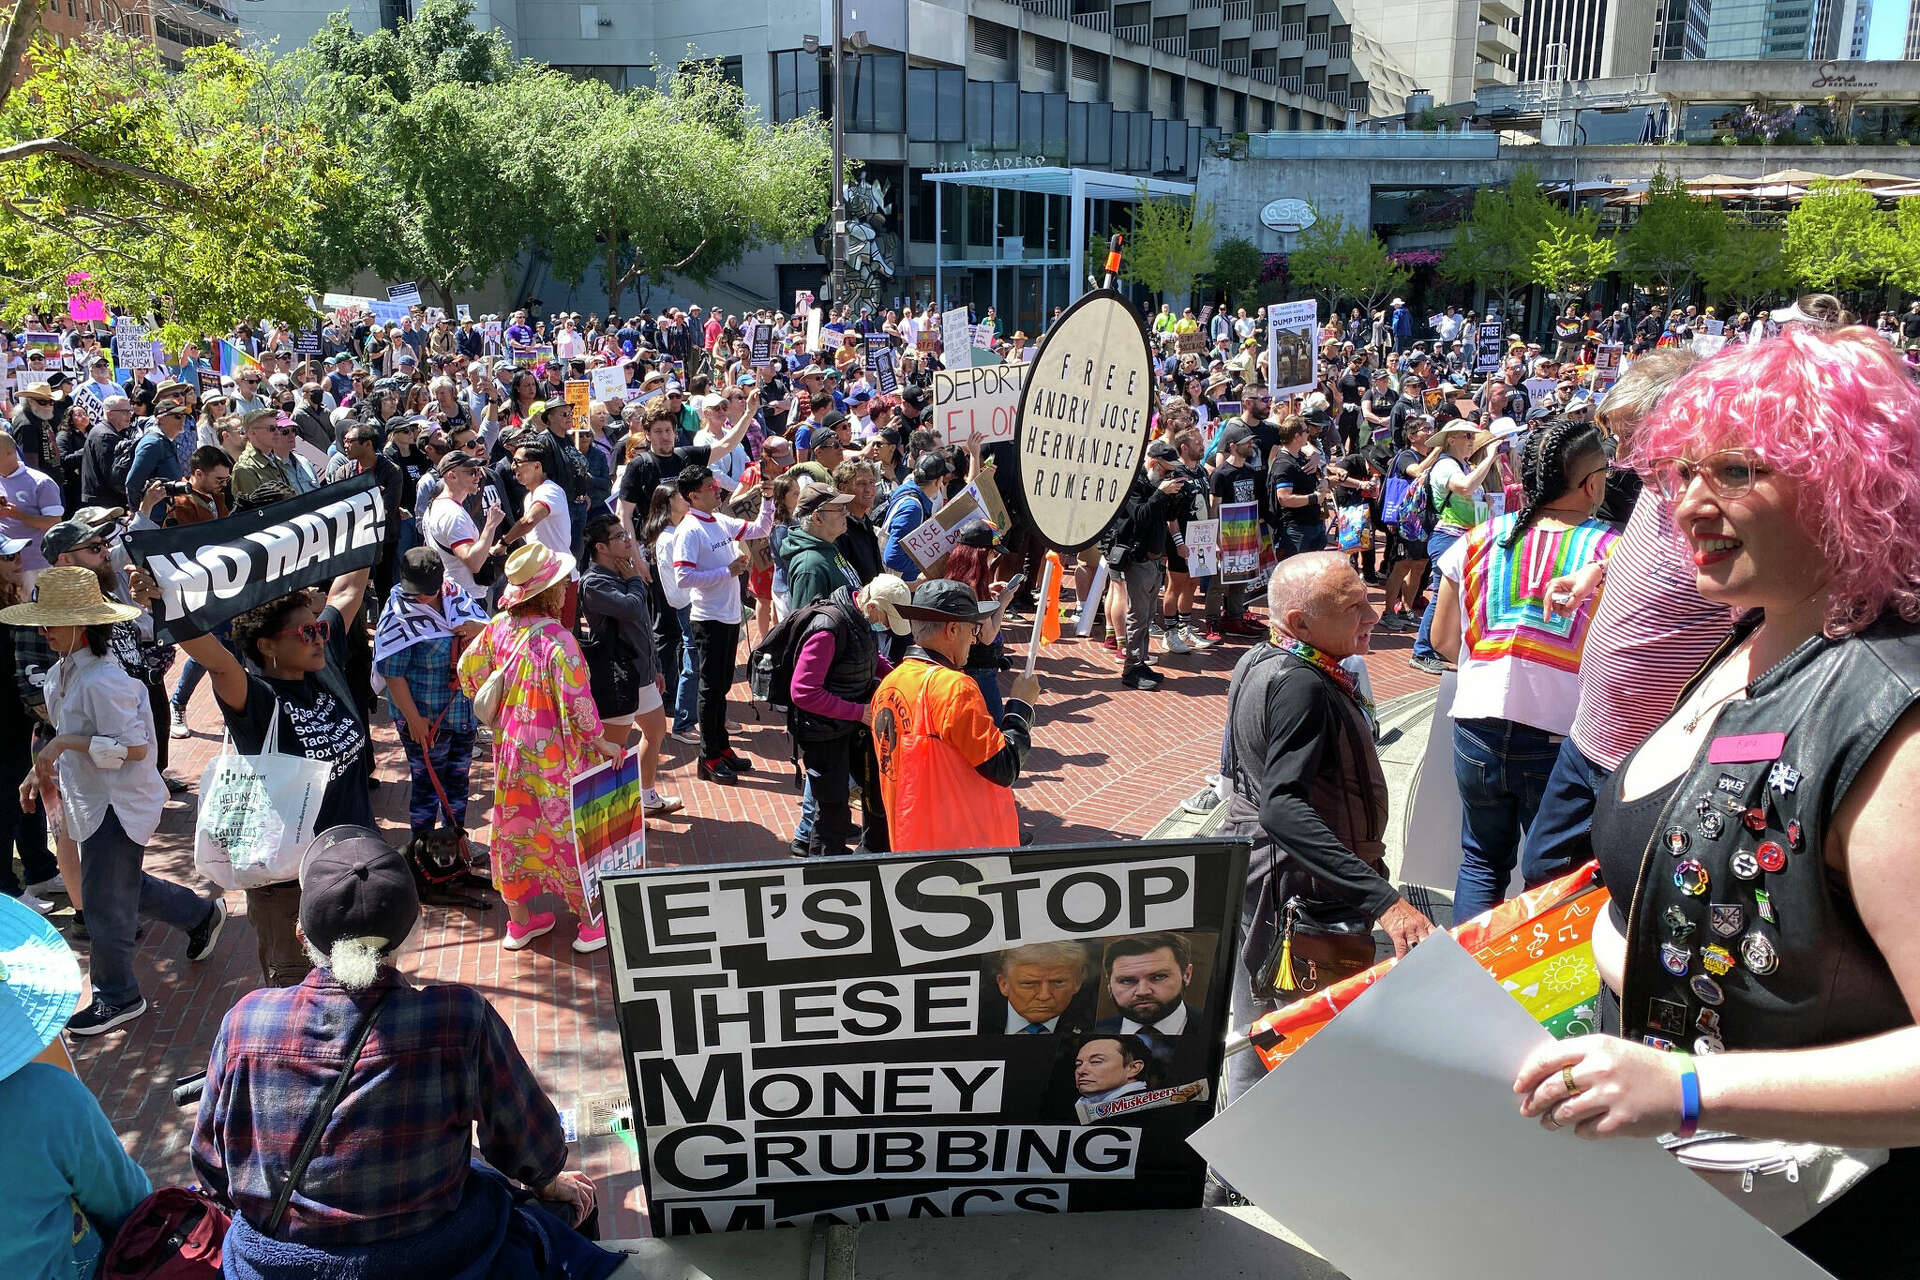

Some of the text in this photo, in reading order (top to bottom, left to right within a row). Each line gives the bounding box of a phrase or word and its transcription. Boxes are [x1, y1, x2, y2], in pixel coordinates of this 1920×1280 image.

[1272, 314, 1315, 326] DUMP TRUMP
[1482, 326, 1499, 336] FREE
[120, 360, 151, 368] FASCISM
[936, 364, 1029, 406] DEPORT
[1062, 354, 1136, 395] FREE
[1034, 388, 1140, 433] ANDRY JOSE
[1026, 426, 1134, 470] HERNANDEZ
[1034, 470, 1118, 503] ROMERO
[146, 486, 386, 622] NO HATE!
[908, 524, 940, 550] RISE
[924, 542, 940, 558] UP
[583, 838, 643, 892] FIGHT
[614, 860, 1189, 970] LET'S STOP
[633, 973, 970, 1056] THESE
[639, 1053, 1000, 1126] MONEY
[1112, 1087, 1178, 1113] Musketeers
[654, 1124, 1132, 1192] GRUBBING
[671, 1188, 1060, 1236] MACS
